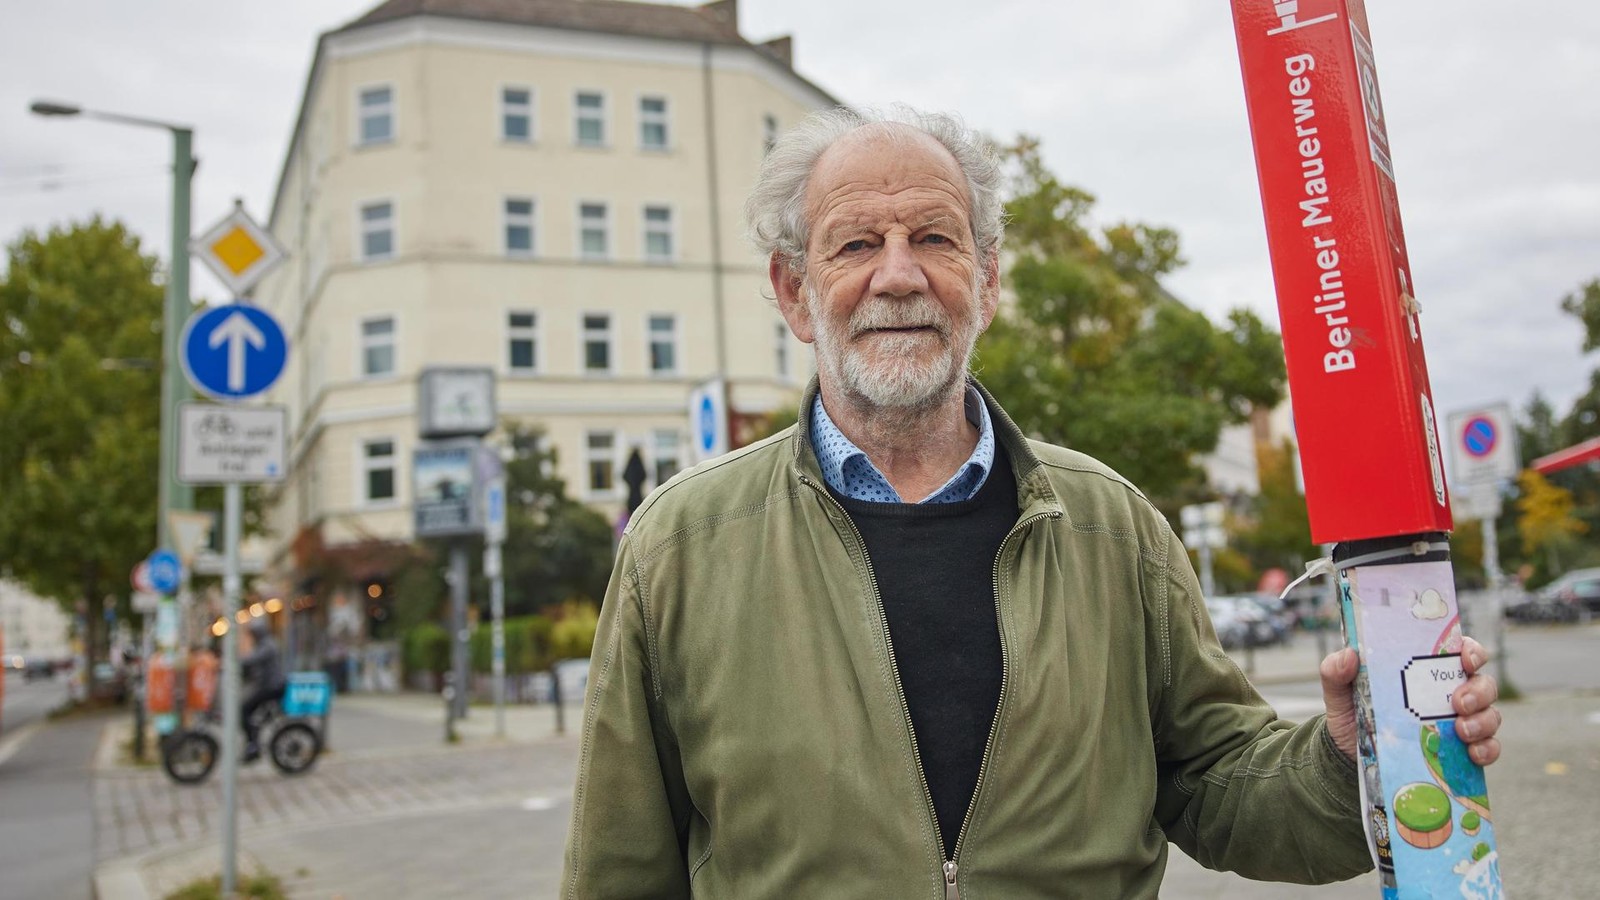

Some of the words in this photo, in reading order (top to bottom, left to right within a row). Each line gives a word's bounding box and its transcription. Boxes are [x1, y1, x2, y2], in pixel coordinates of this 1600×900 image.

[1284, 52, 1333, 228] Mauerweg
[1313, 236, 1356, 373] Berliner
[1430, 668, 1455, 681] You
